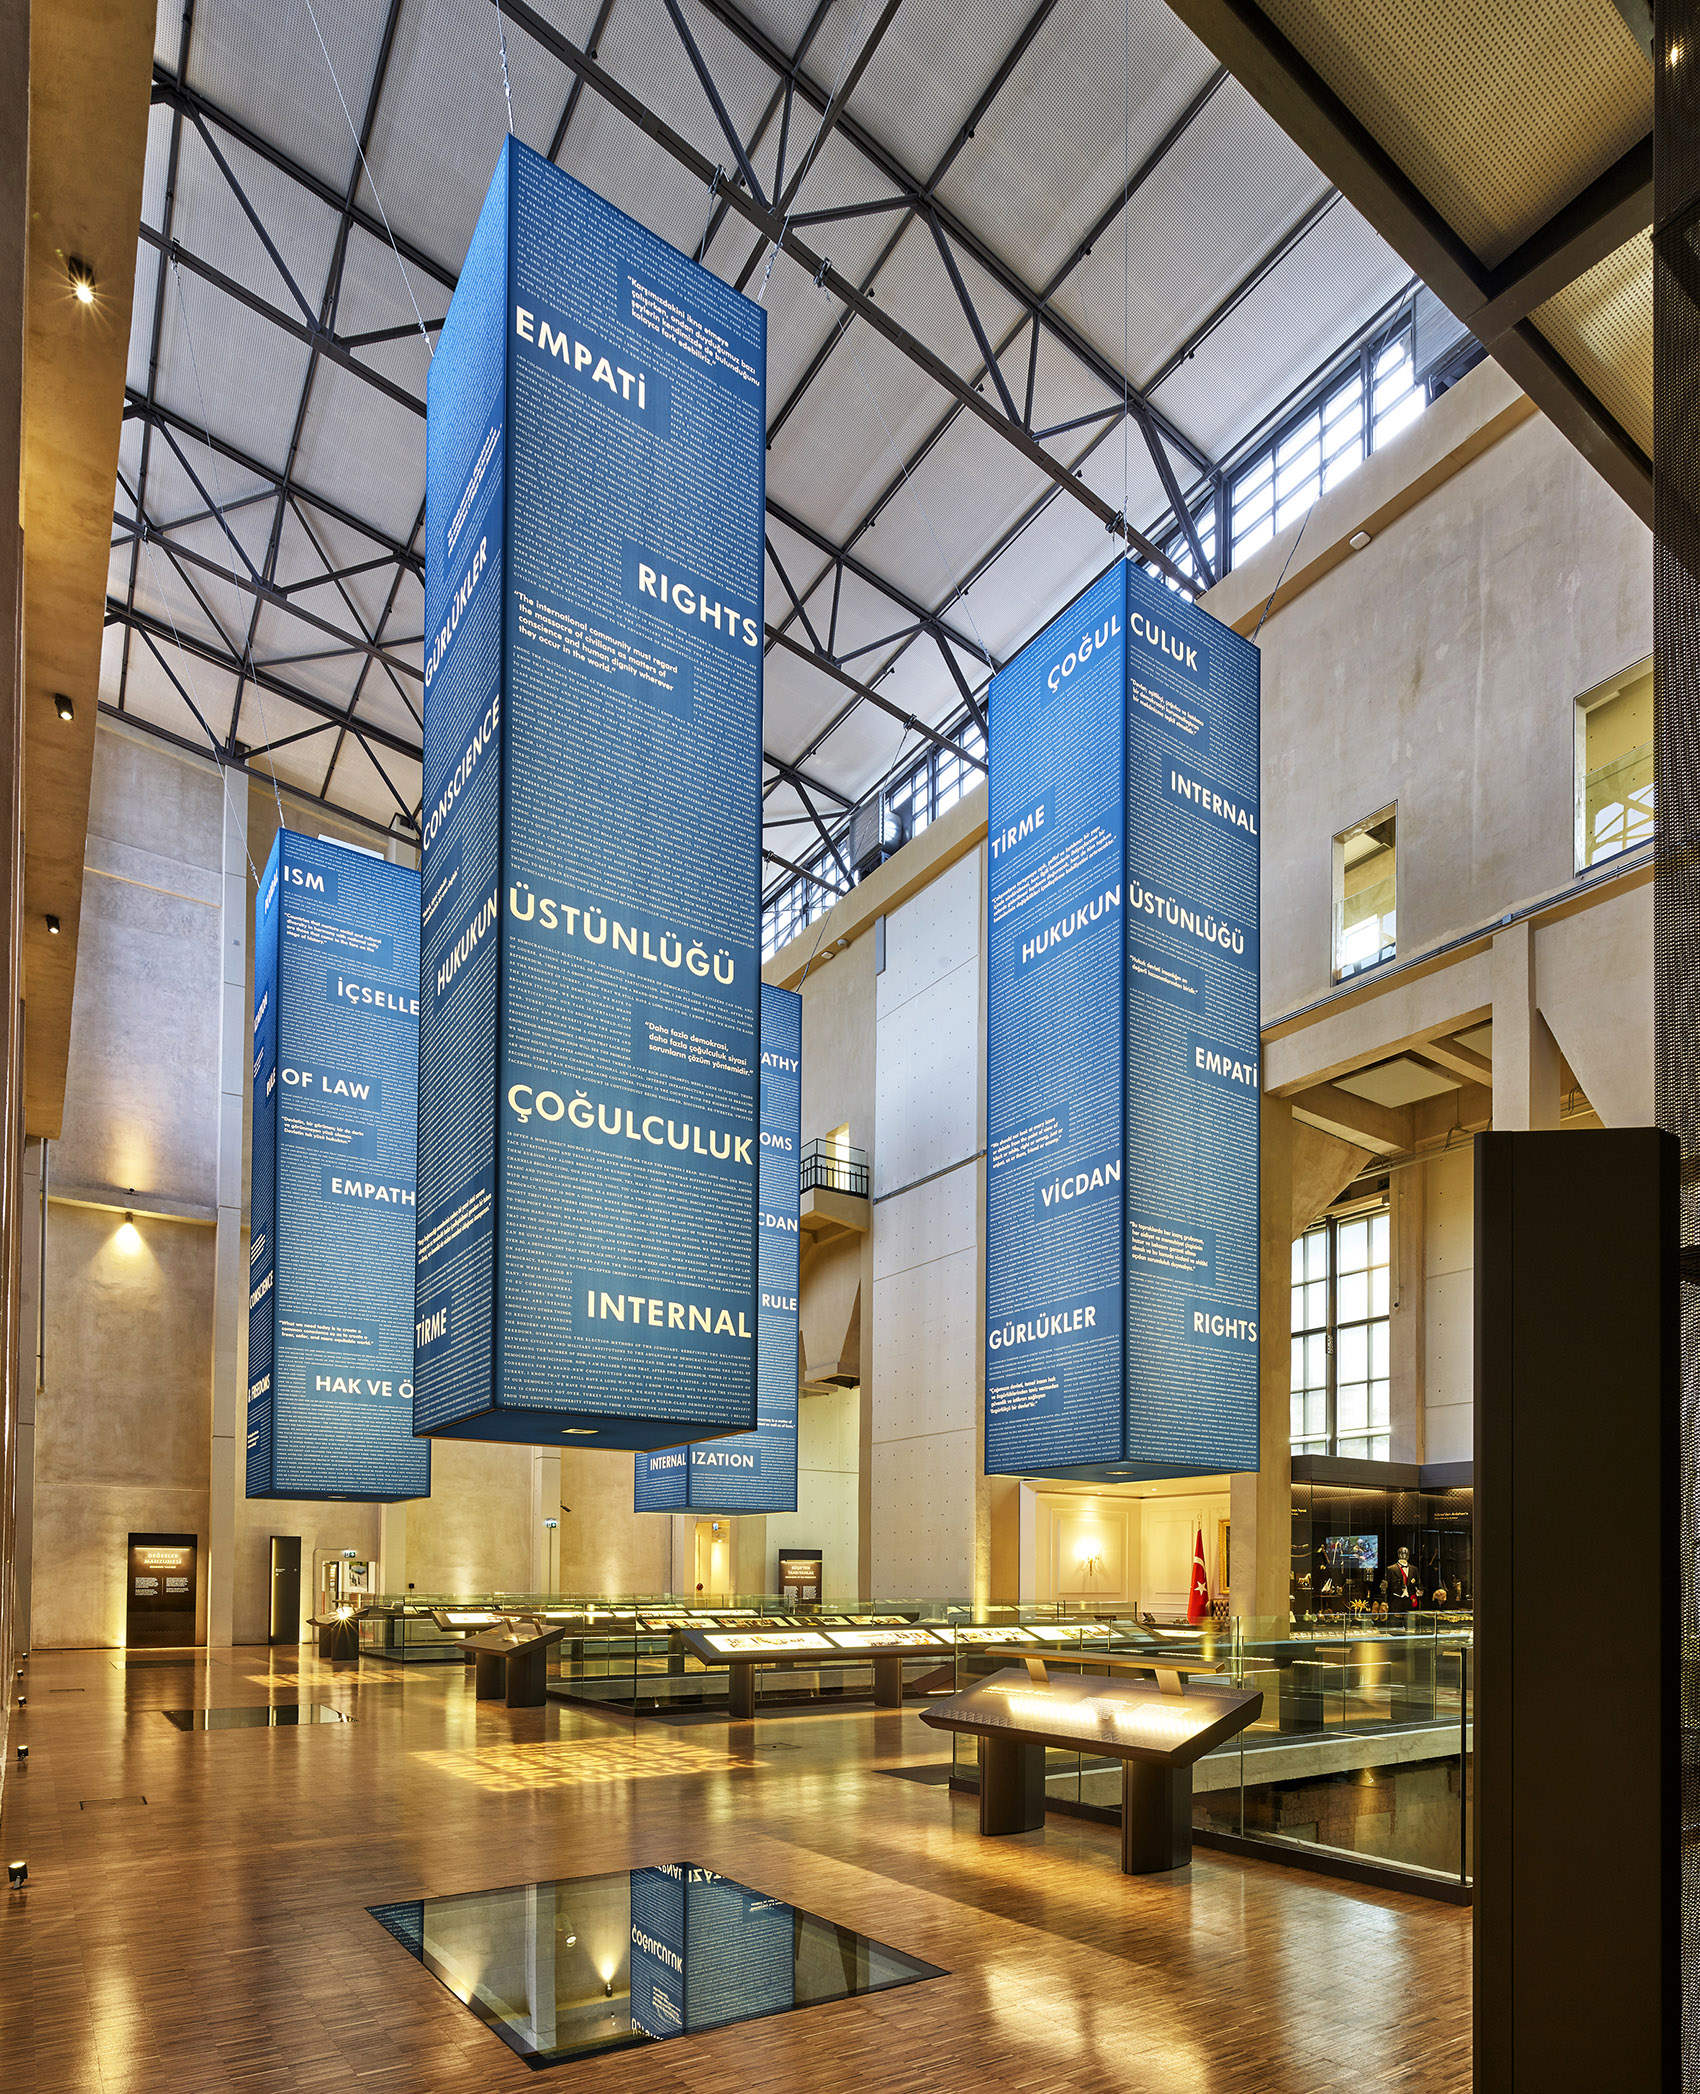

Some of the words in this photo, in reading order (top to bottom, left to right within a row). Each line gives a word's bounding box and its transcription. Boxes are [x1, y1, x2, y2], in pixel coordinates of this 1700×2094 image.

[631, 308, 660, 332] kolayca
[662, 327, 676, 343] fark
[662, 318, 703, 349] kendimizde
[704, 345, 713, 356] de
[671, 315, 693, 334] ondan
[741, 359, 755, 374] bazı
[687, 314, 702, 330] ikna
[704, 328, 729, 347] etmeye
[515, 304, 648, 410] EMPATİ
[425, 536, 487, 688] GÜRLÜKLER
[638, 562, 758, 647] RIGHTS
[518, 603, 533, 616] the
[535, 613, 573, 634] massacre
[575, 631, 583, 639] of
[585, 635, 616, 654] civilians
[629, 657, 656, 673] matters
[658, 669, 666, 678] of
[518, 624, 537, 641] they
[539, 636, 561, 649] occur
[563, 644, 570, 654] in
[573, 649, 585, 661] the
[518, 616, 562, 640] conscience
[564, 637, 580, 648] and
[582, 643, 609, 661] human
[611, 656, 637, 677] dignity
[639, 671, 674, 691] wherever
[536, 600, 587, 631] international
[589, 628, 631, 654] community
[633, 649, 651, 661] must
[653, 658, 678, 673] regard
[1047, 614, 1121, 694] ÇOĞUL
[1130, 612, 1198, 672] CULUK
[422, 693, 499, 851] CONSCIENCE
[1171, 770, 1258, 835] INTERNAL
[991, 804, 1045, 859] TİRME
[284, 865, 325, 893] ISM
[509, 881, 735, 985] ÜSTÜNLÜĞÜ
[1021, 884, 1121, 964] HUKUKUN
[1129, 879, 1244, 955] ÜSTÜNLÜĞÜ
[437, 888, 498, 996] HUKUKUN
[648, 1032, 668, 1044] daha
[670, 1038, 687, 1049] fazla
[689, 1045, 726, 1060] çoğulculuk
[728, 1055, 747, 1065] siyasi
[648, 1044, 686, 1059] sorunların
[688, 1054, 710, 1065] çözüm
[671, 1028, 688, 1039] fazla
[690, 1034, 729, 1053] demokrasi,
[760, 1051, 799, 1073] ATHY
[281, 1068, 313, 1088] OF
[322, 1076, 370, 1100] LAW
[1195, 1046, 1258, 1088] EMPATİ
[507, 1084, 753, 1165] ÇOĞULCULUK
[759, 1131, 793, 1151] OMS
[331, 1177, 415, 1206] EMPATH
[1040, 1160, 1121, 1207] VİCDAN
[587, 1290, 752, 1338] INTERNAL
[761, 1293, 797, 1311] RULE
[415, 1307, 447, 1349] TİRME
[989, 1305, 1097, 1350] GÜRLÜKLER
[1193, 1311, 1258, 1342] RIGHTS
[315, 1375, 362, 1395] HAK
[366, 1379, 392, 1397] VE
[398, 1378, 413, 1399] Ö
[649, 1453, 687, 1471] INTERNAL
[691, 1451, 754, 1468] IZATION
